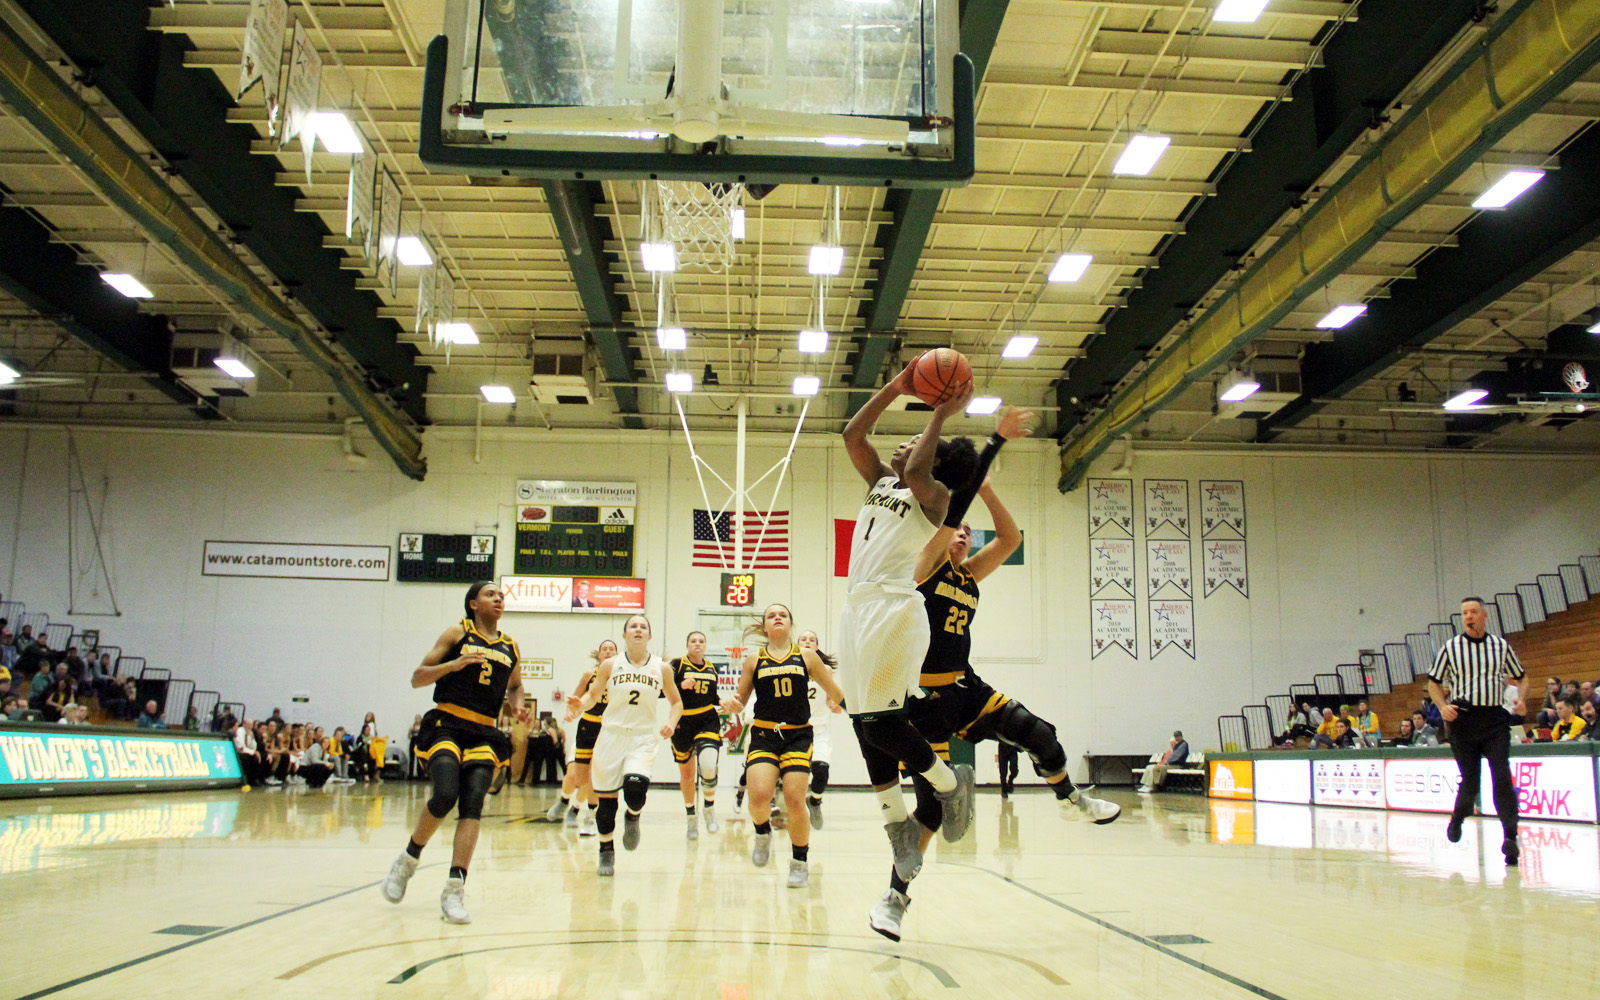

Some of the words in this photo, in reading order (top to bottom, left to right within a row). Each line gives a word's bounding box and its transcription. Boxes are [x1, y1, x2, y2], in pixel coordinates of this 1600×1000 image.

[581, 487, 636, 496] Burlington
[1100, 481, 1128, 490] AMERICA
[1156, 482, 1184, 490] AMERICA
[1212, 483, 1239, 491] AMERICA
[518, 523, 551, 531] VERMONT
[603, 525, 626, 533] GUEST
[864, 517, 875, 541] 1
[1102, 541, 1130, 549] AMERICA
[1158, 542, 1186, 550] AMERICA
[1214, 542, 1242, 550] AMERICA
[208, 553, 385, 569] www.catamountstore.com
[403, 553, 424, 561] HOME
[466, 554, 489, 562] GUEST
[733, 575, 753, 587] 1:08
[504, 579, 569, 602] xfinity
[726, 585, 749, 605] 28
[1103, 602, 1131, 610] AMERICA
[1161, 602, 1189, 610] AMERICA
[944, 605, 968, 635] 22
[479, 662, 493, 686] 2
[612, 673, 660, 691] VERMONT
[694, 680, 710, 694] 45
[773, 677, 793, 698] 10
[628, 690, 640, 705] 2
[0, 736, 105, 780] WOMEN'S
[101, 739, 210, 779] BASKETBALL
[1518, 789, 1571, 817] BANK
